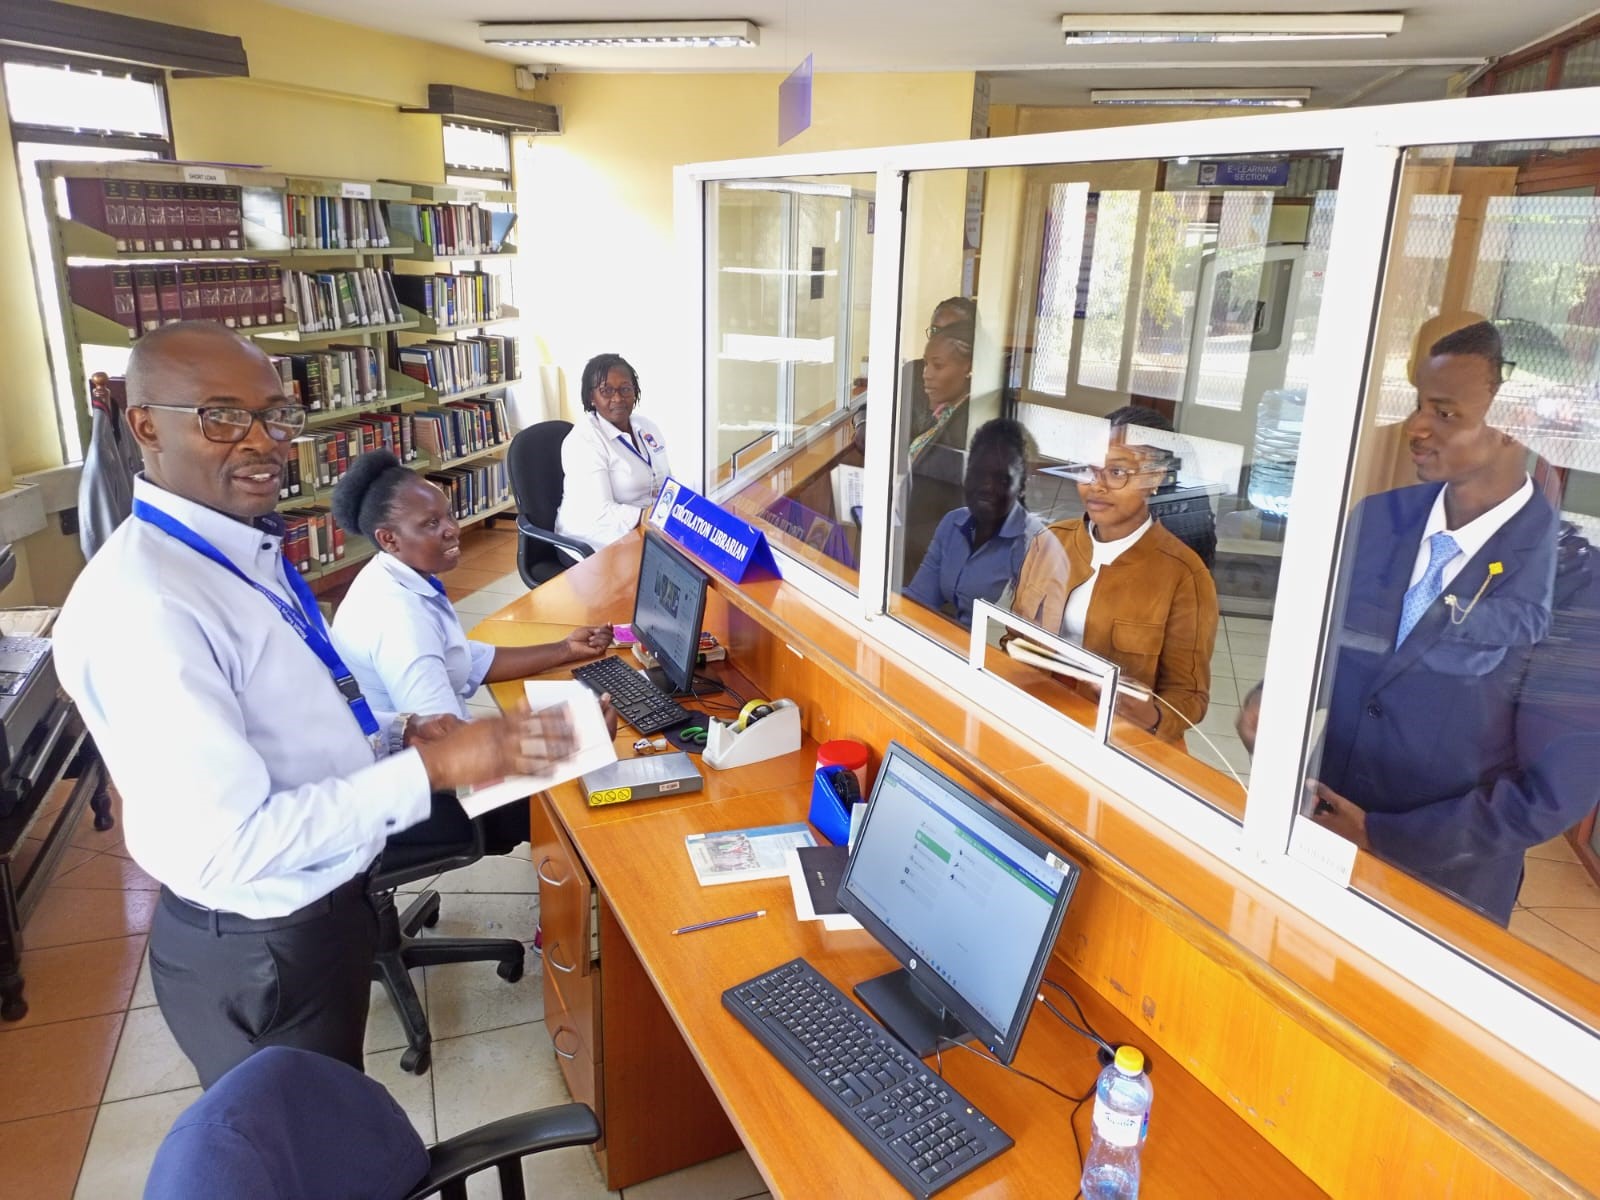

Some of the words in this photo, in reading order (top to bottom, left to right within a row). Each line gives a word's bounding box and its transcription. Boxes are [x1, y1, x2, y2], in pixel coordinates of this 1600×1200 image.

[1227, 165, 1278, 174] E-LEARNING
[1234, 173, 1268, 181] SECTION
[671, 503, 712, 538] CIRCULATION
[709, 527, 749, 562] LIBRARIAN
